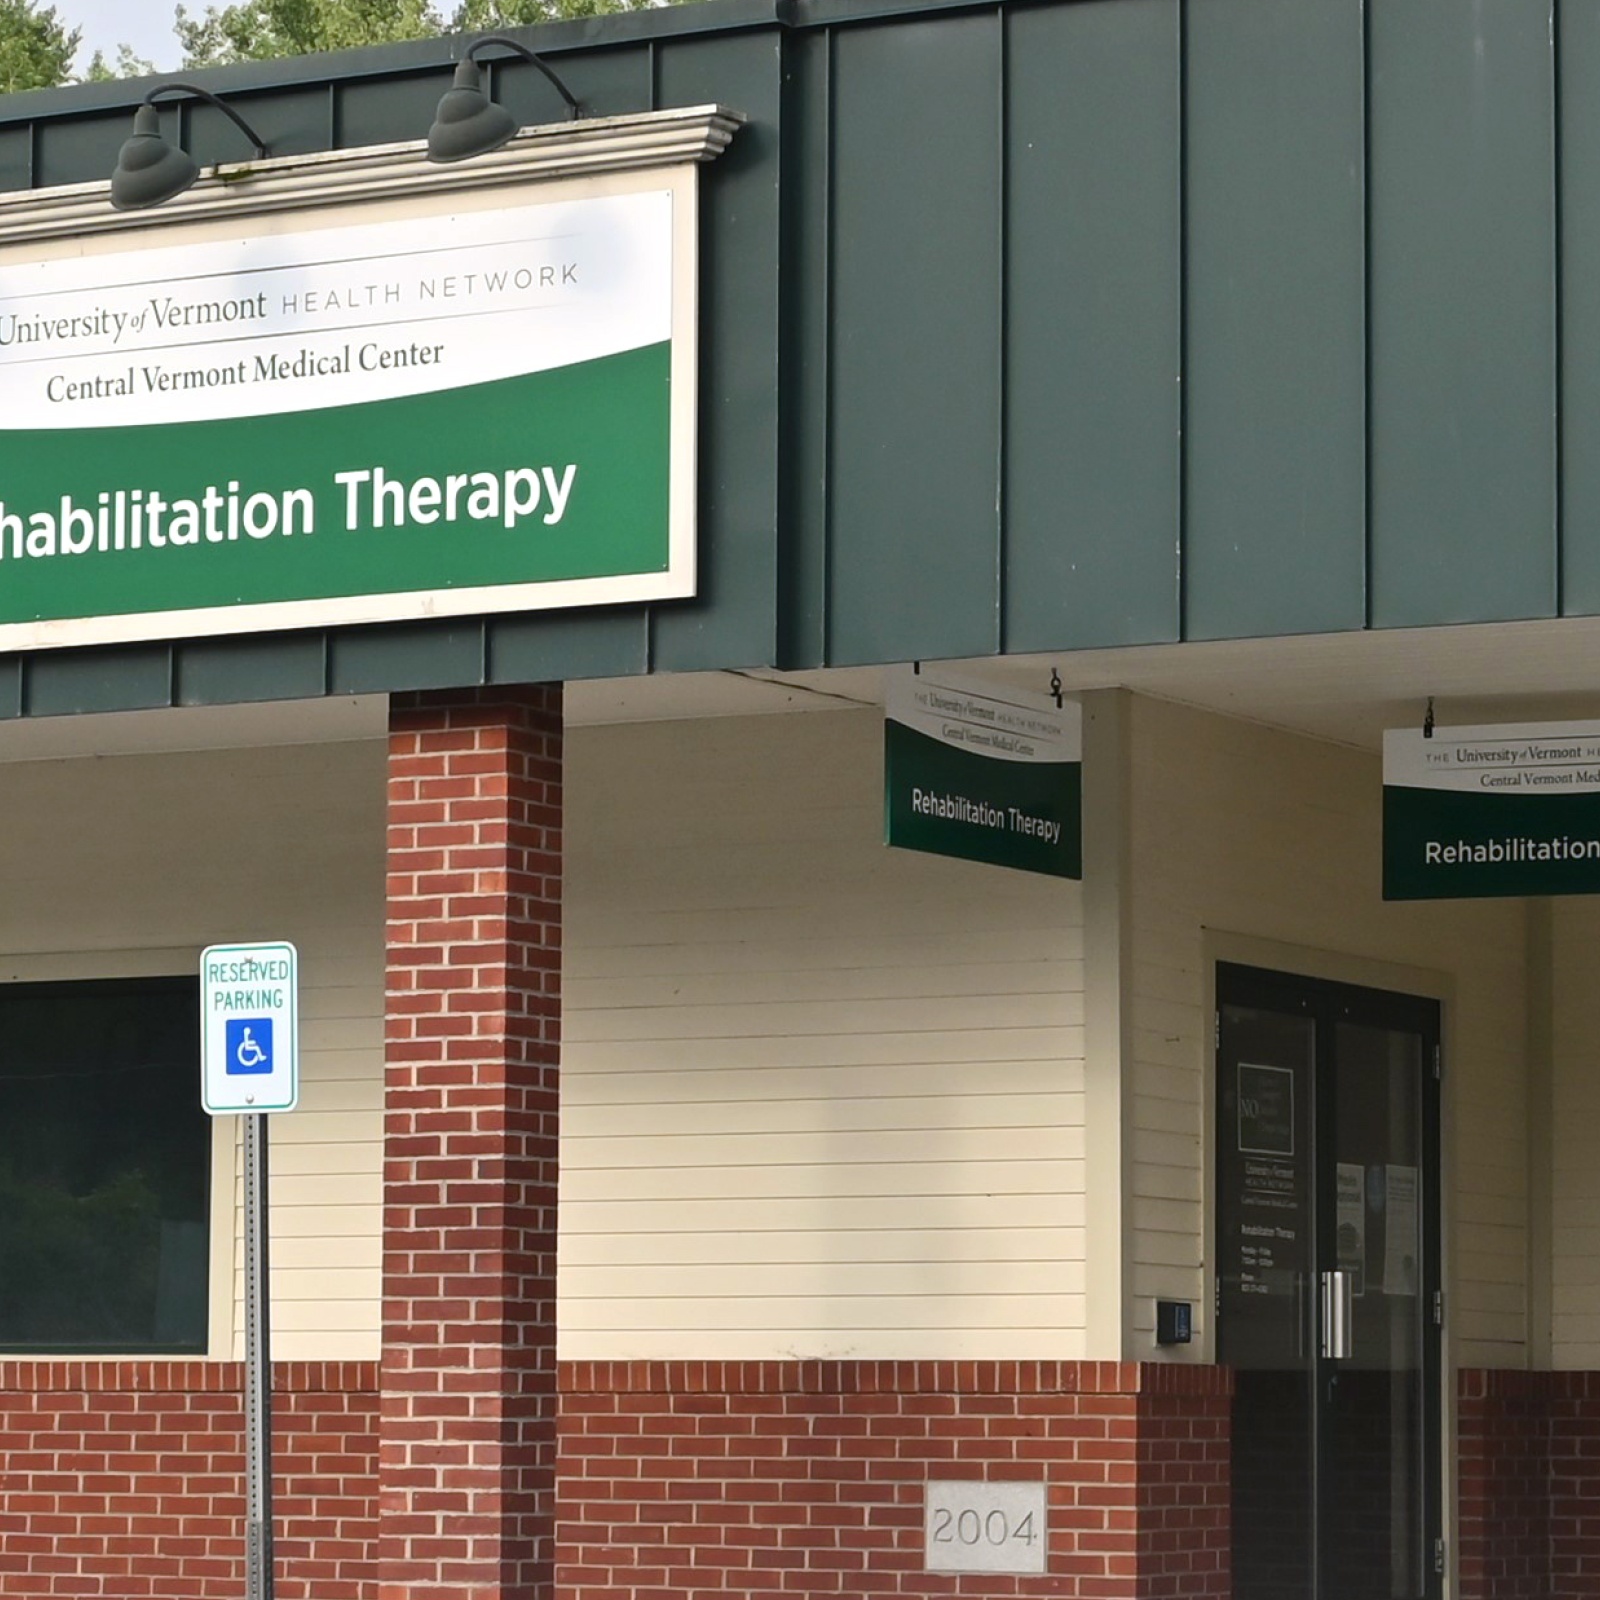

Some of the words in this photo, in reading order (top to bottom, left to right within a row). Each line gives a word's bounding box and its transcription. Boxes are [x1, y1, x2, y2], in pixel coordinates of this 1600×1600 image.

[130, 308, 149, 333] of
[150, 291, 267, 329] Vermont
[282, 284, 401, 315] HEALTH
[419, 263, 578, 301] NETWORK
[46, 368, 135, 402] Central
[143, 360, 247, 393] Vermont
[252, 345, 350, 382] Medical
[358, 342, 445, 372] Center
[334, 464, 577, 531] Therapy
[1426, 752, 1450, 763] THE
[1456, 747, 1518, 764] University
[1528, 745, 1581, 760] Vermont
[1480, 773, 1521, 787] Central
[1524, 772, 1573, 785] Vermont
[911, 787, 1004, 829] Rehabilitation
[1008, 807, 1061, 845] Therapy
[209, 961, 289, 983] RESERVED
[214, 989, 284, 1011] PARKING
[933, 1508, 1037, 1547] 2004
